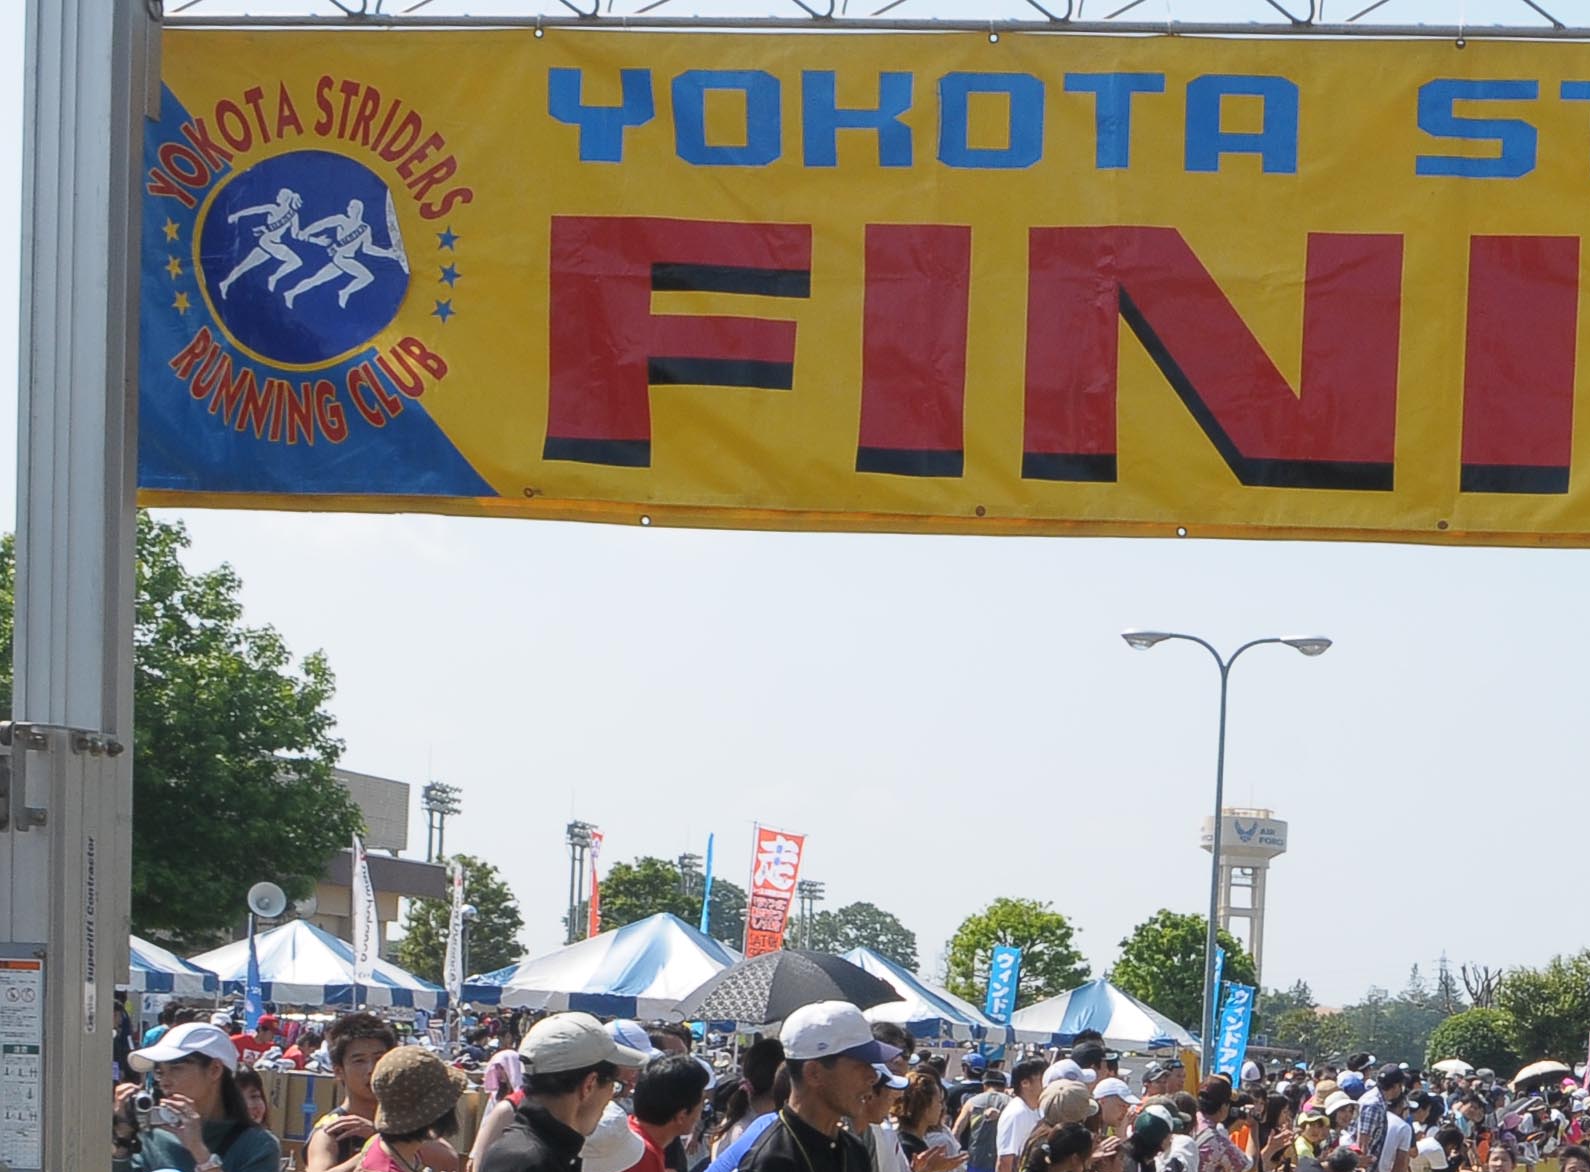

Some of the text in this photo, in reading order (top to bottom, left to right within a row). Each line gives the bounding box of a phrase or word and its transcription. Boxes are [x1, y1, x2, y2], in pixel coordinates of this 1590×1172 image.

[147, 75, 475, 222] YOKOTA STRIDERS
[547, 67, 1300, 174] YOKOTA
[169, 326, 449, 446] RUNNING CLUB
[86, 836, 96, 916] Contractor
